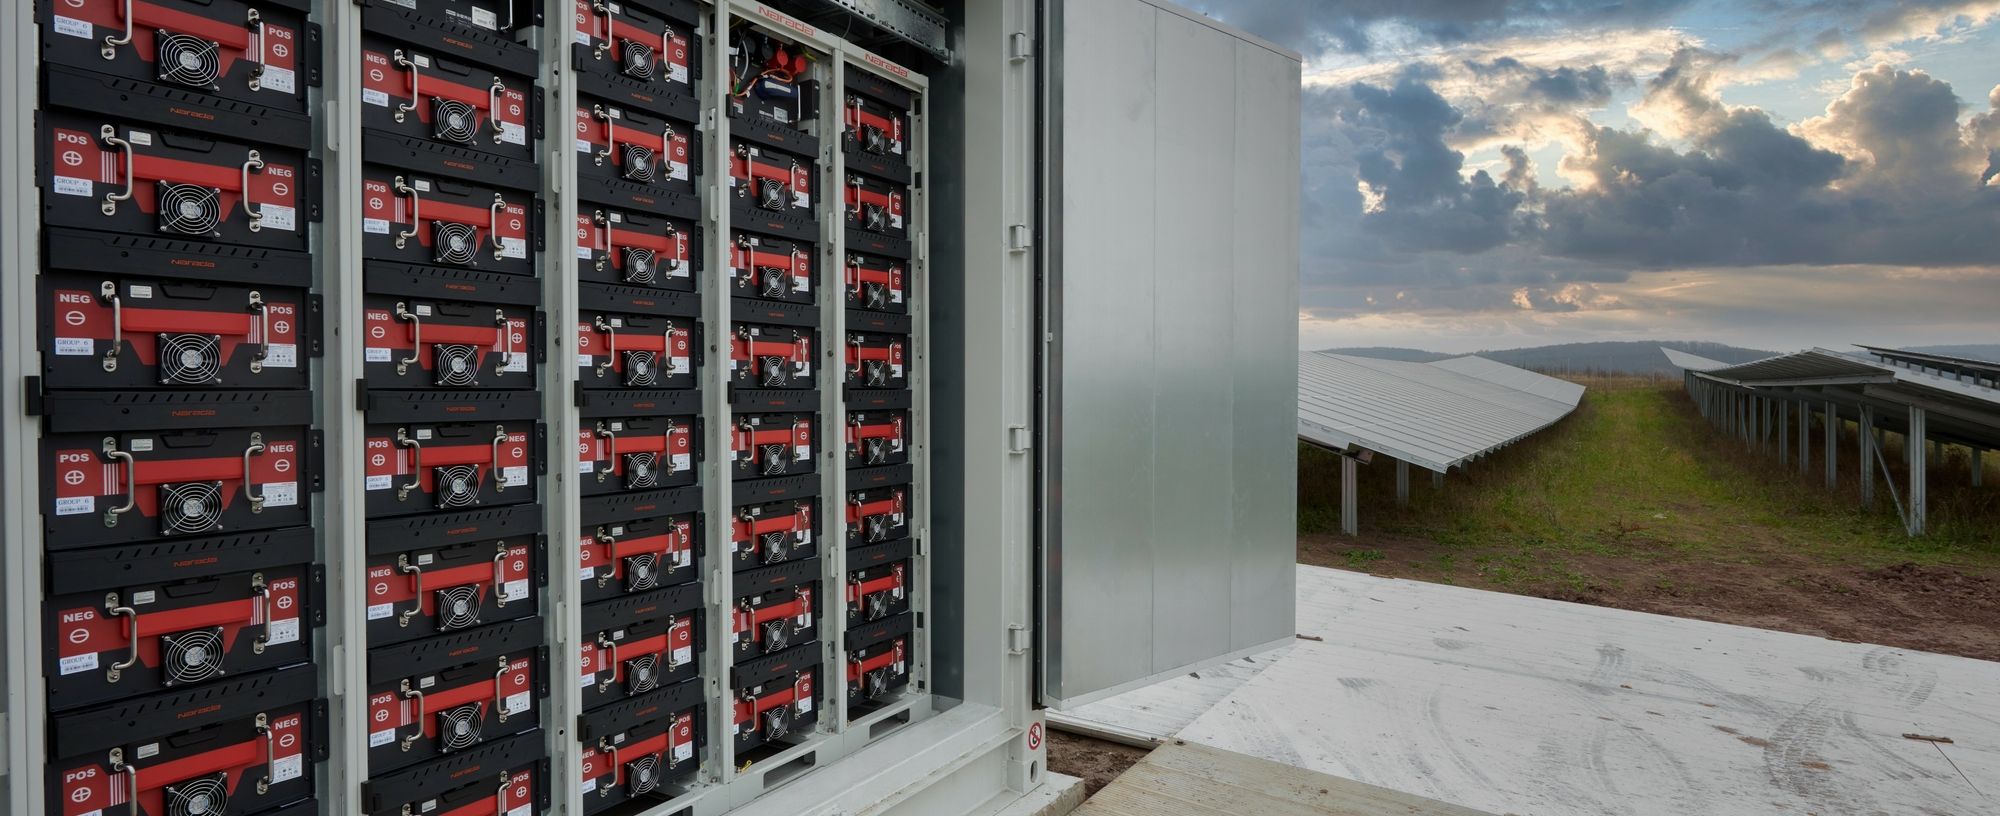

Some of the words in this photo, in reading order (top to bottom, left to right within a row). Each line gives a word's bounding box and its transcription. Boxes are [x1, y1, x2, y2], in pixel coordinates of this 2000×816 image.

[56, 17, 79, 26] GROUP
[759, 6, 815, 37] Narada
[269, 27, 291, 39] POS
[366, 54, 387, 65] NEG
[865, 53, 908, 77] Narada
[507, 92, 523, 101] POS
[58, 133, 87, 145] POS
[269, 167, 292, 177] NEG
[367, 183, 386, 193] POS
[507, 206, 524, 215] NEG
[60, 294, 91, 303] NEG
[271, 306, 293, 315] POS
[368, 313, 388, 321] NEG
[270, 445, 293, 453] NEG
[60, 453, 89, 463] POS
[510, 548, 526, 556] POS
[371, 568, 391, 578] NEG
[273, 581, 295, 591] POS
[63, 611, 94, 623] NEG
[62, 656, 84, 665] GROUP
[512, 661, 528, 670] NEG
[372, 695, 392, 705] POS
[275, 718, 299, 730] NEG
[66, 768, 95, 783] POS
[513, 773, 529, 784] POS
